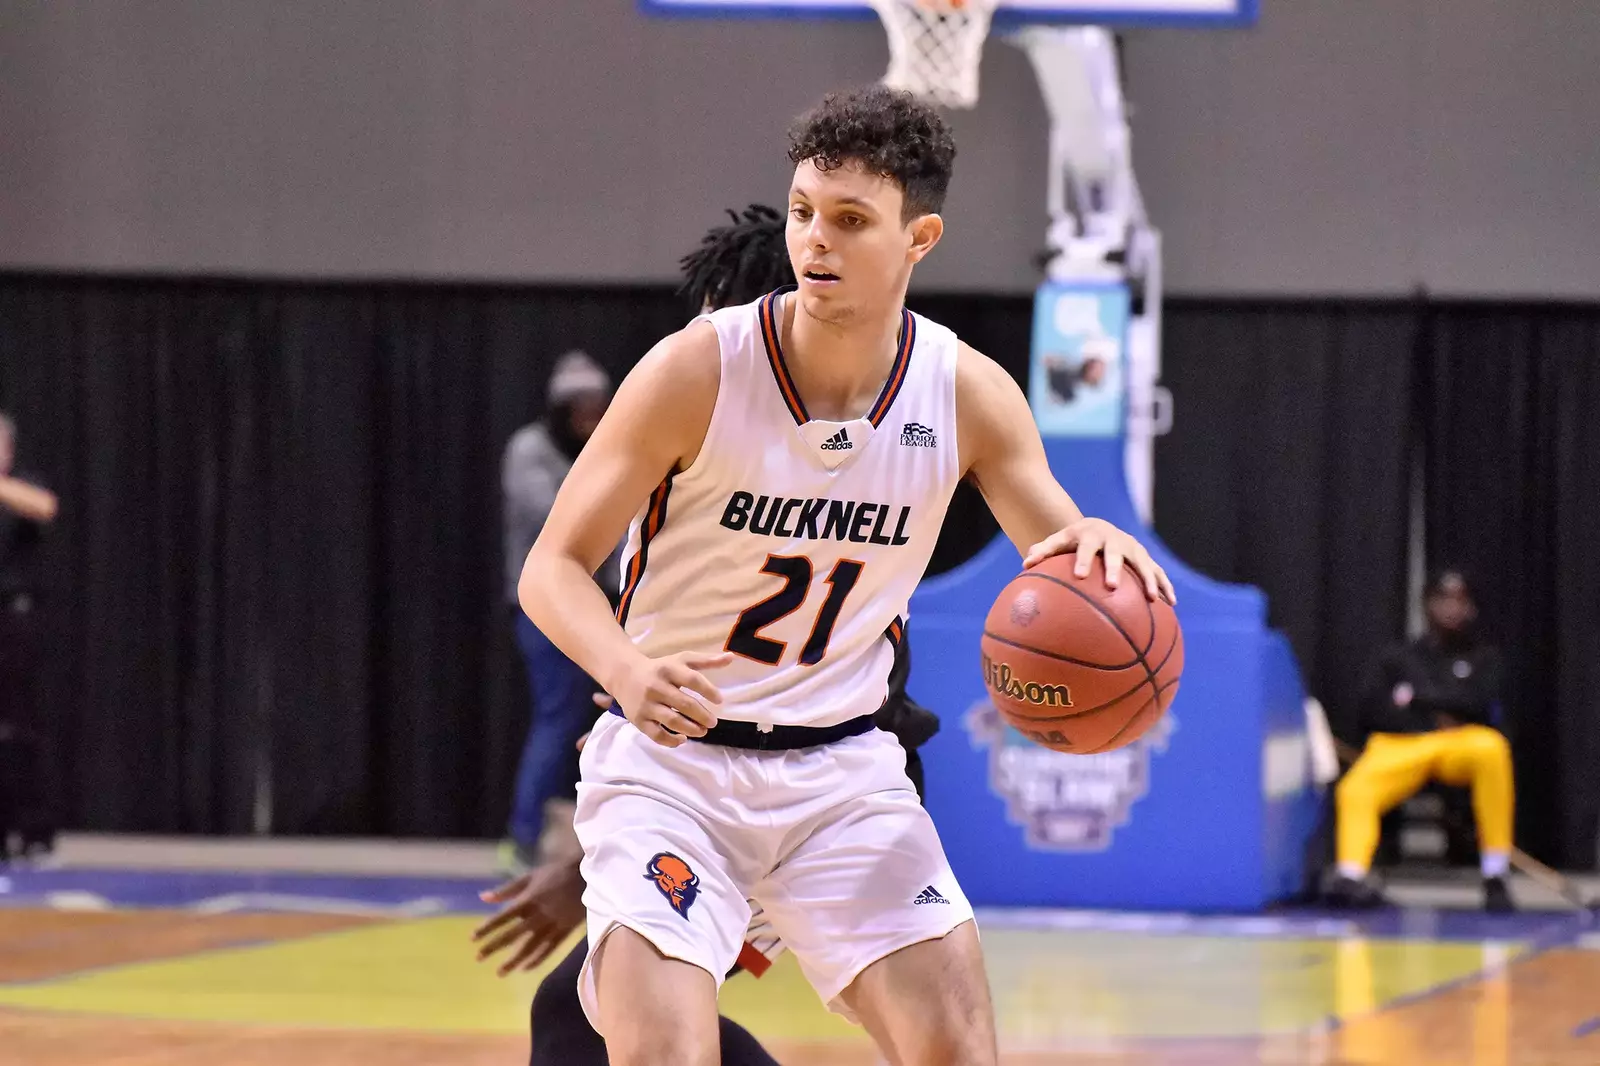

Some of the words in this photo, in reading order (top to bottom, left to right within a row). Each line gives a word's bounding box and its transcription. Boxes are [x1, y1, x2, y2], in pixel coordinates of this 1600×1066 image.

[900, 434, 937, 443] PATRIOT
[820, 440, 853, 451] adidas
[900, 440, 937, 448] LEAGUE
[719, 490, 911, 546] BUCKNELL
[723, 553, 866, 667] 21
[913, 896, 951, 905] adidas
